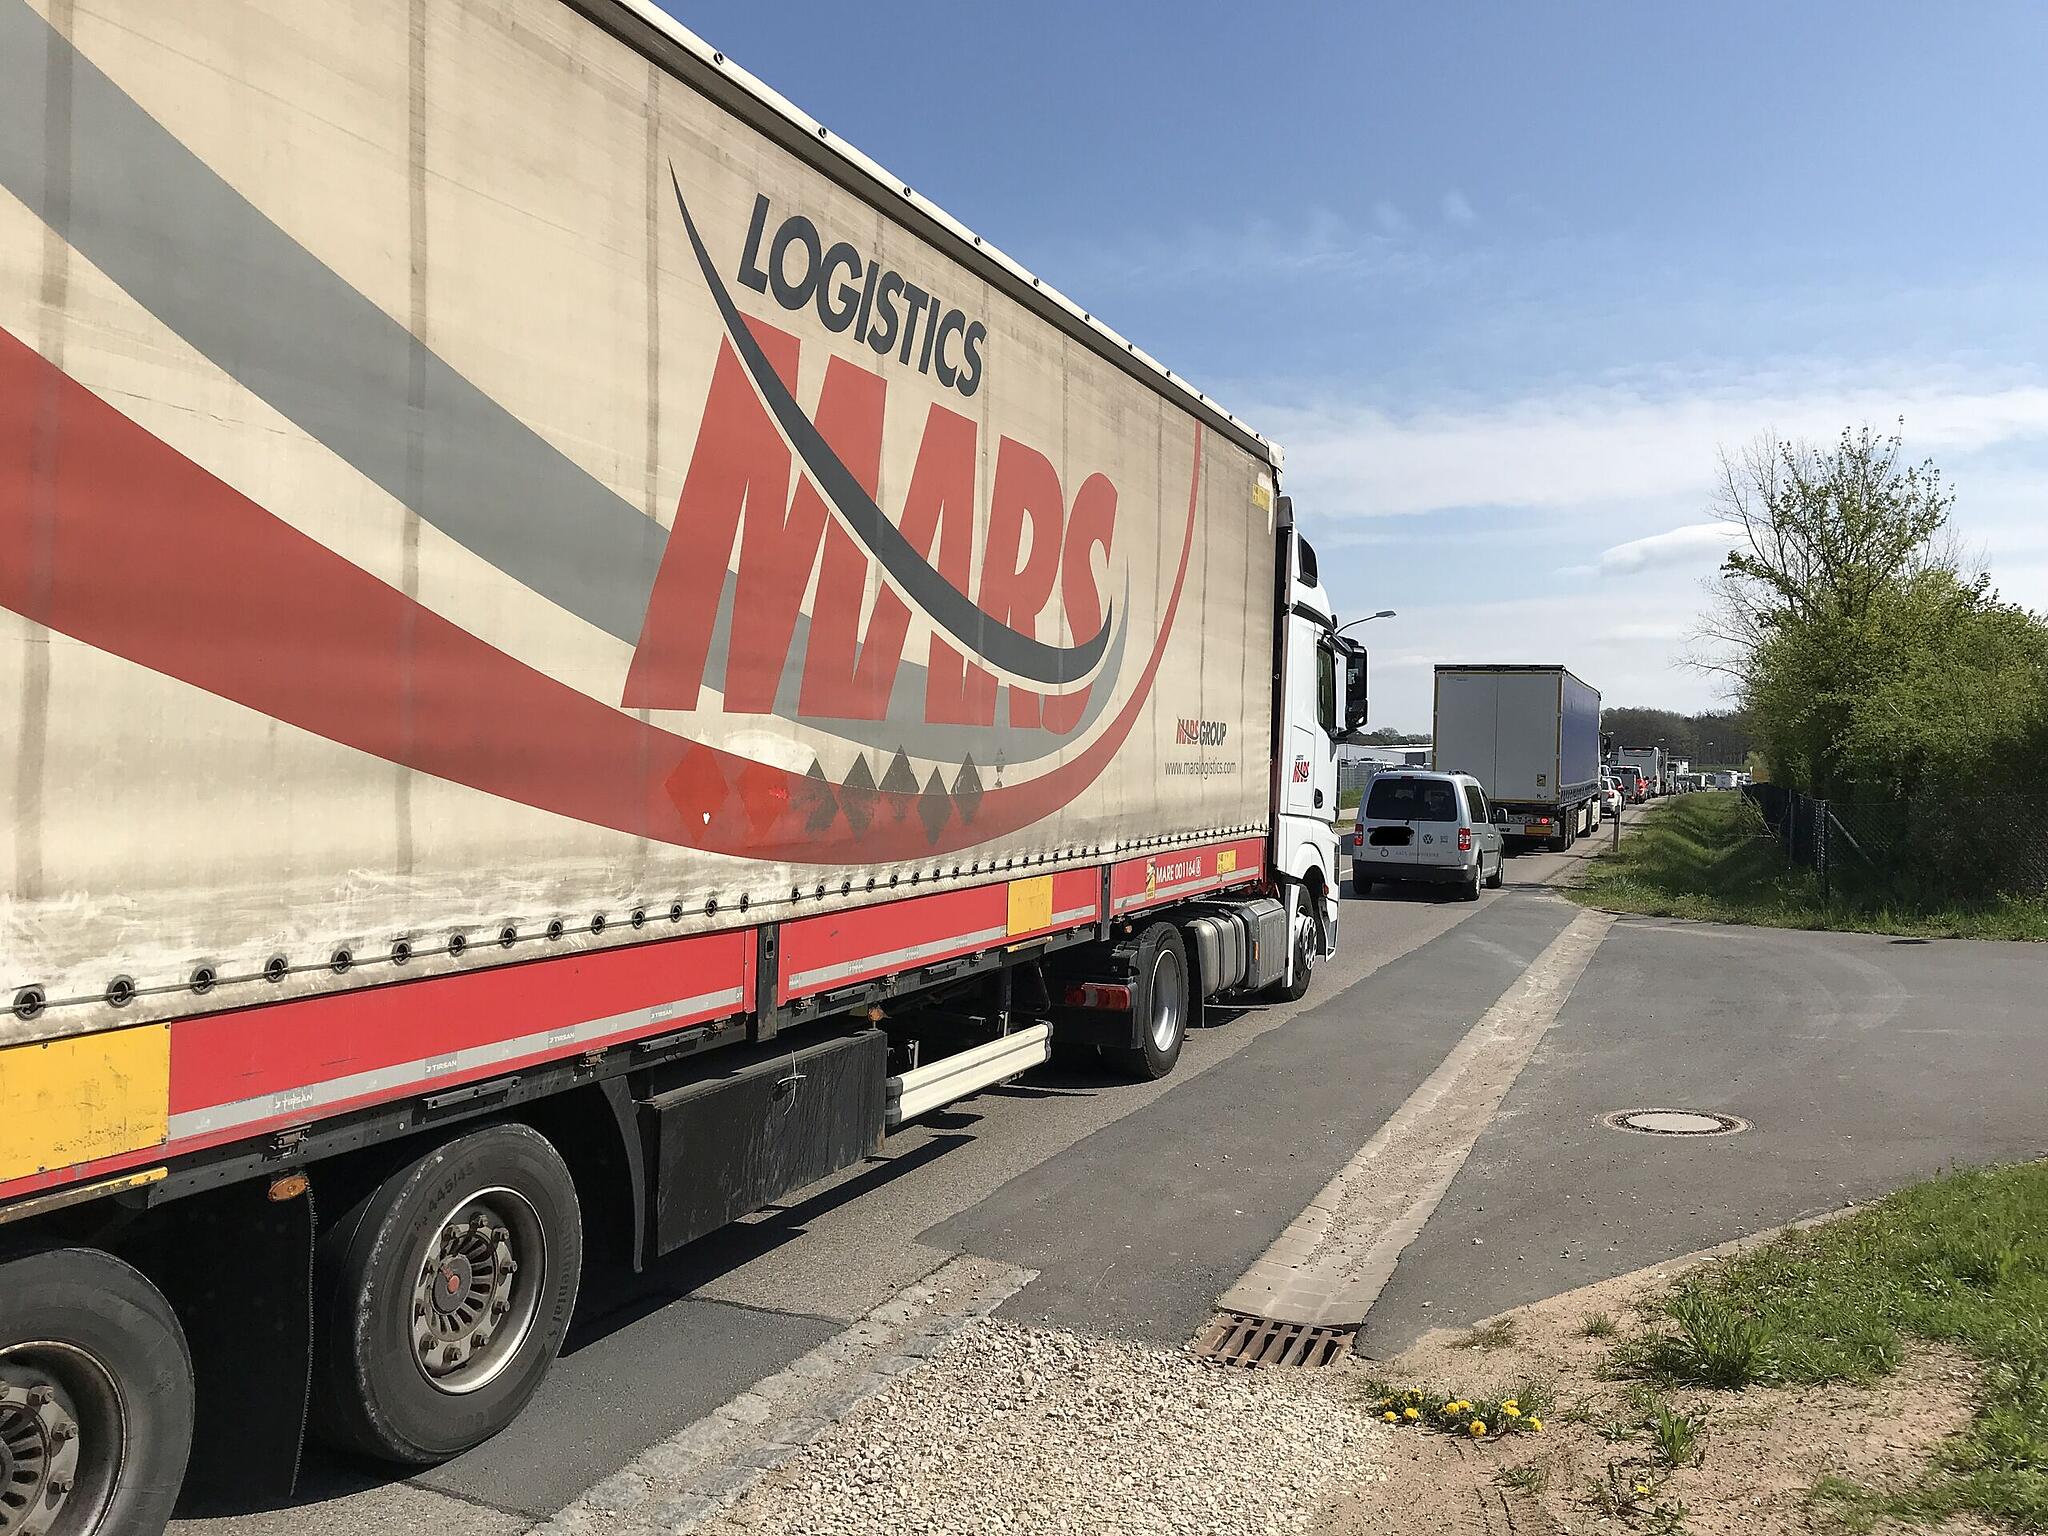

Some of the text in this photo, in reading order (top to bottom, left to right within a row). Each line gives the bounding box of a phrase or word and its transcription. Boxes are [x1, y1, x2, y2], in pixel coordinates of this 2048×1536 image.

[737, 193, 987, 397] LOGISTICS
[622, 311, 1118, 735] MARS
[1175, 719, 1227, 746] MARS GROUP
[1164, 756, 1237, 780] www.marslogistics.com
[1156, 864, 1174, 884] MARE
[553, 1032, 576, 1043] TIRSAN
[432, 1060, 458, 1072] TIRSAN
